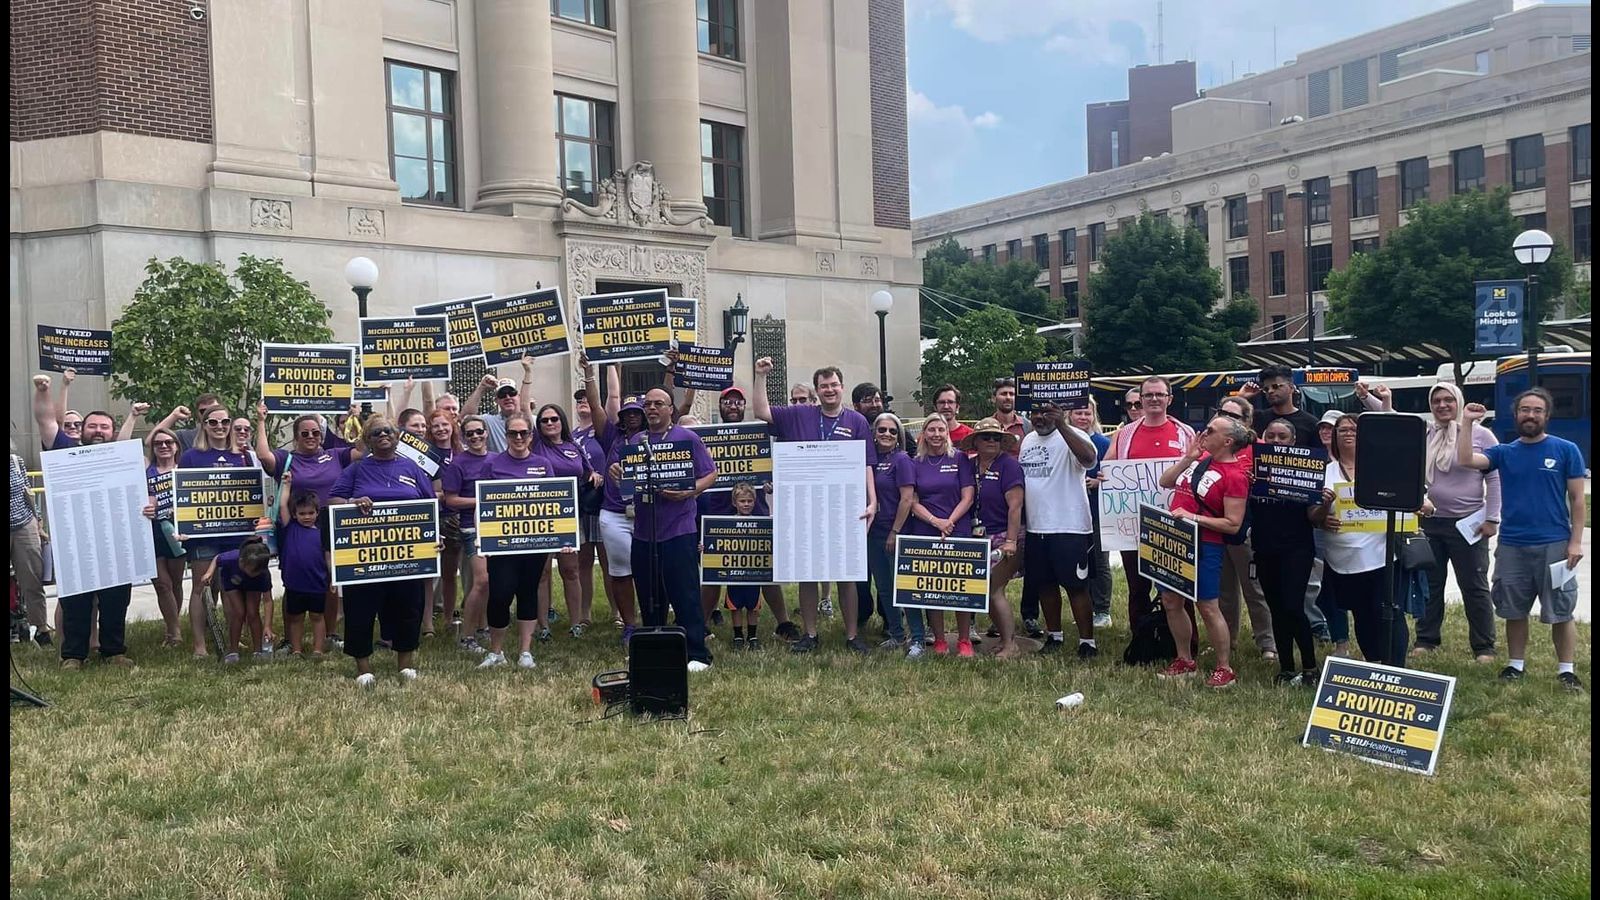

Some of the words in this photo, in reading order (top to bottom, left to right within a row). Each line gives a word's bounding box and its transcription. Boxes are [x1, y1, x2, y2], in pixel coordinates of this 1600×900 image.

[1493, 288, 1506, 298] M
[445, 303, 465, 311] MAKE
[482, 306, 518, 318] MICHIGAN
[519, 300, 554, 311] MEDICINE
[506, 298, 527, 307] MAKE
[587, 304, 625, 314] MICHIGAN
[625, 301, 661, 311] MEDICINE
[1484, 310, 1505, 318] Look
[491, 313, 546, 334] PROVIDER
[596, 313, 655, 330] EMPLOYER
[1480, 317, 1518, 326] Michigan
[55, 328, 68, 336] WE
[501, 328, 548, 348] CHOICE
[603, 330, 650, 345] CHOICE
[44, 335, 64, 345] WAGE
[65, 338, 109, 348] INCREASES
[376, 337, 434, 351] EMPLOYER
[382, 353, 429, 366] CHOICE
[679, 353, 697, 362] WAGE
[698, 355, 733, 365] INCREASES
[278, 368, 335, 380] PROVIDER
[1023, 372, 1045, 381] WAGE
[1046, 371, 1089, 381] INCREASES
[1306, 372, 1313, 382] TO
[1313, 372, 1330, 382] NORTH
[1330, 372, 1350, 382] CAMPUS
[284, 384, 332, 396] CHOICE
[402, 433, 429, 453] SPEND
[652, 442, 674, 451] NEED
[706, 444, 758, 459] MPLOYER
[1274, 446, 1287, 454] WE
[1288, 447, 1311, 456] NEED
[661, 462, 681, 470] RETAIN
[716, 460, 753, 473] HOICE
[1261, 454, 1283, 465] WAGE
[1284, 457, 1324, 470] INCREASES
[660, 470, 687, 478] WORKERS
[1271, 467, 1295, 477] RESPECT,
[1295, 471, 1313, 479] RETAIN
[1271, 476, 1293, 485] RECRUIT
[1293, 479, 1317, 489] WORKERS
[191, 490, 250, 504] EMPLOYER
[486, 492, 528, 500] MICHIGAN
[528, 490, 569, 498] MEDICINE
[197, 506, 245, 519] CHOICE
[372, 508, 399, 516] MAKE
[495, 503, 561, 518] EMPLOYER
[340, 516, 387, 526] MICHIGAN
[387, 513, 430, 523] MEDICINE
[1161, 516, 1175, 526] MAKE
[502, 520, 555, 535] CHOICE
[335, 537, 349, 545] AN
[351, 526, 421, 545] EMPLOYER
[423, 530, 436, 538] OF
[716, 539, 772, 551] PROVIDER
[1141, 532, 1148, 540] AN
[1149, 531, 1187, 558] EMPLOYER
[1187, 552, 1194, 560] OF
[358, 545, 415, 563] CHOICE
[904, 548, 943, 557] MICHIGAN
[944, 550, 982, 559] MEDICINE
[722, 555, 769, 568] CHOICE
[912, 560, 973, 576] EMPLOYER
[1152, 549, 1183, 574] CHOICE
[916, 577, 966, 592] CHOICE
[1369, 672, 1401, 684] MAKE
[1332, 675, 1385, 691] MICHIGAN
[1384, 683, 1439, 700] MEDICINE
[1325, 695, 1333, 703] A
[1336, 691, 1416, 722] PROVIDER
[1417, 713, 1434, 722] OF
[1338, 714, 1408, 743] CHOICE
